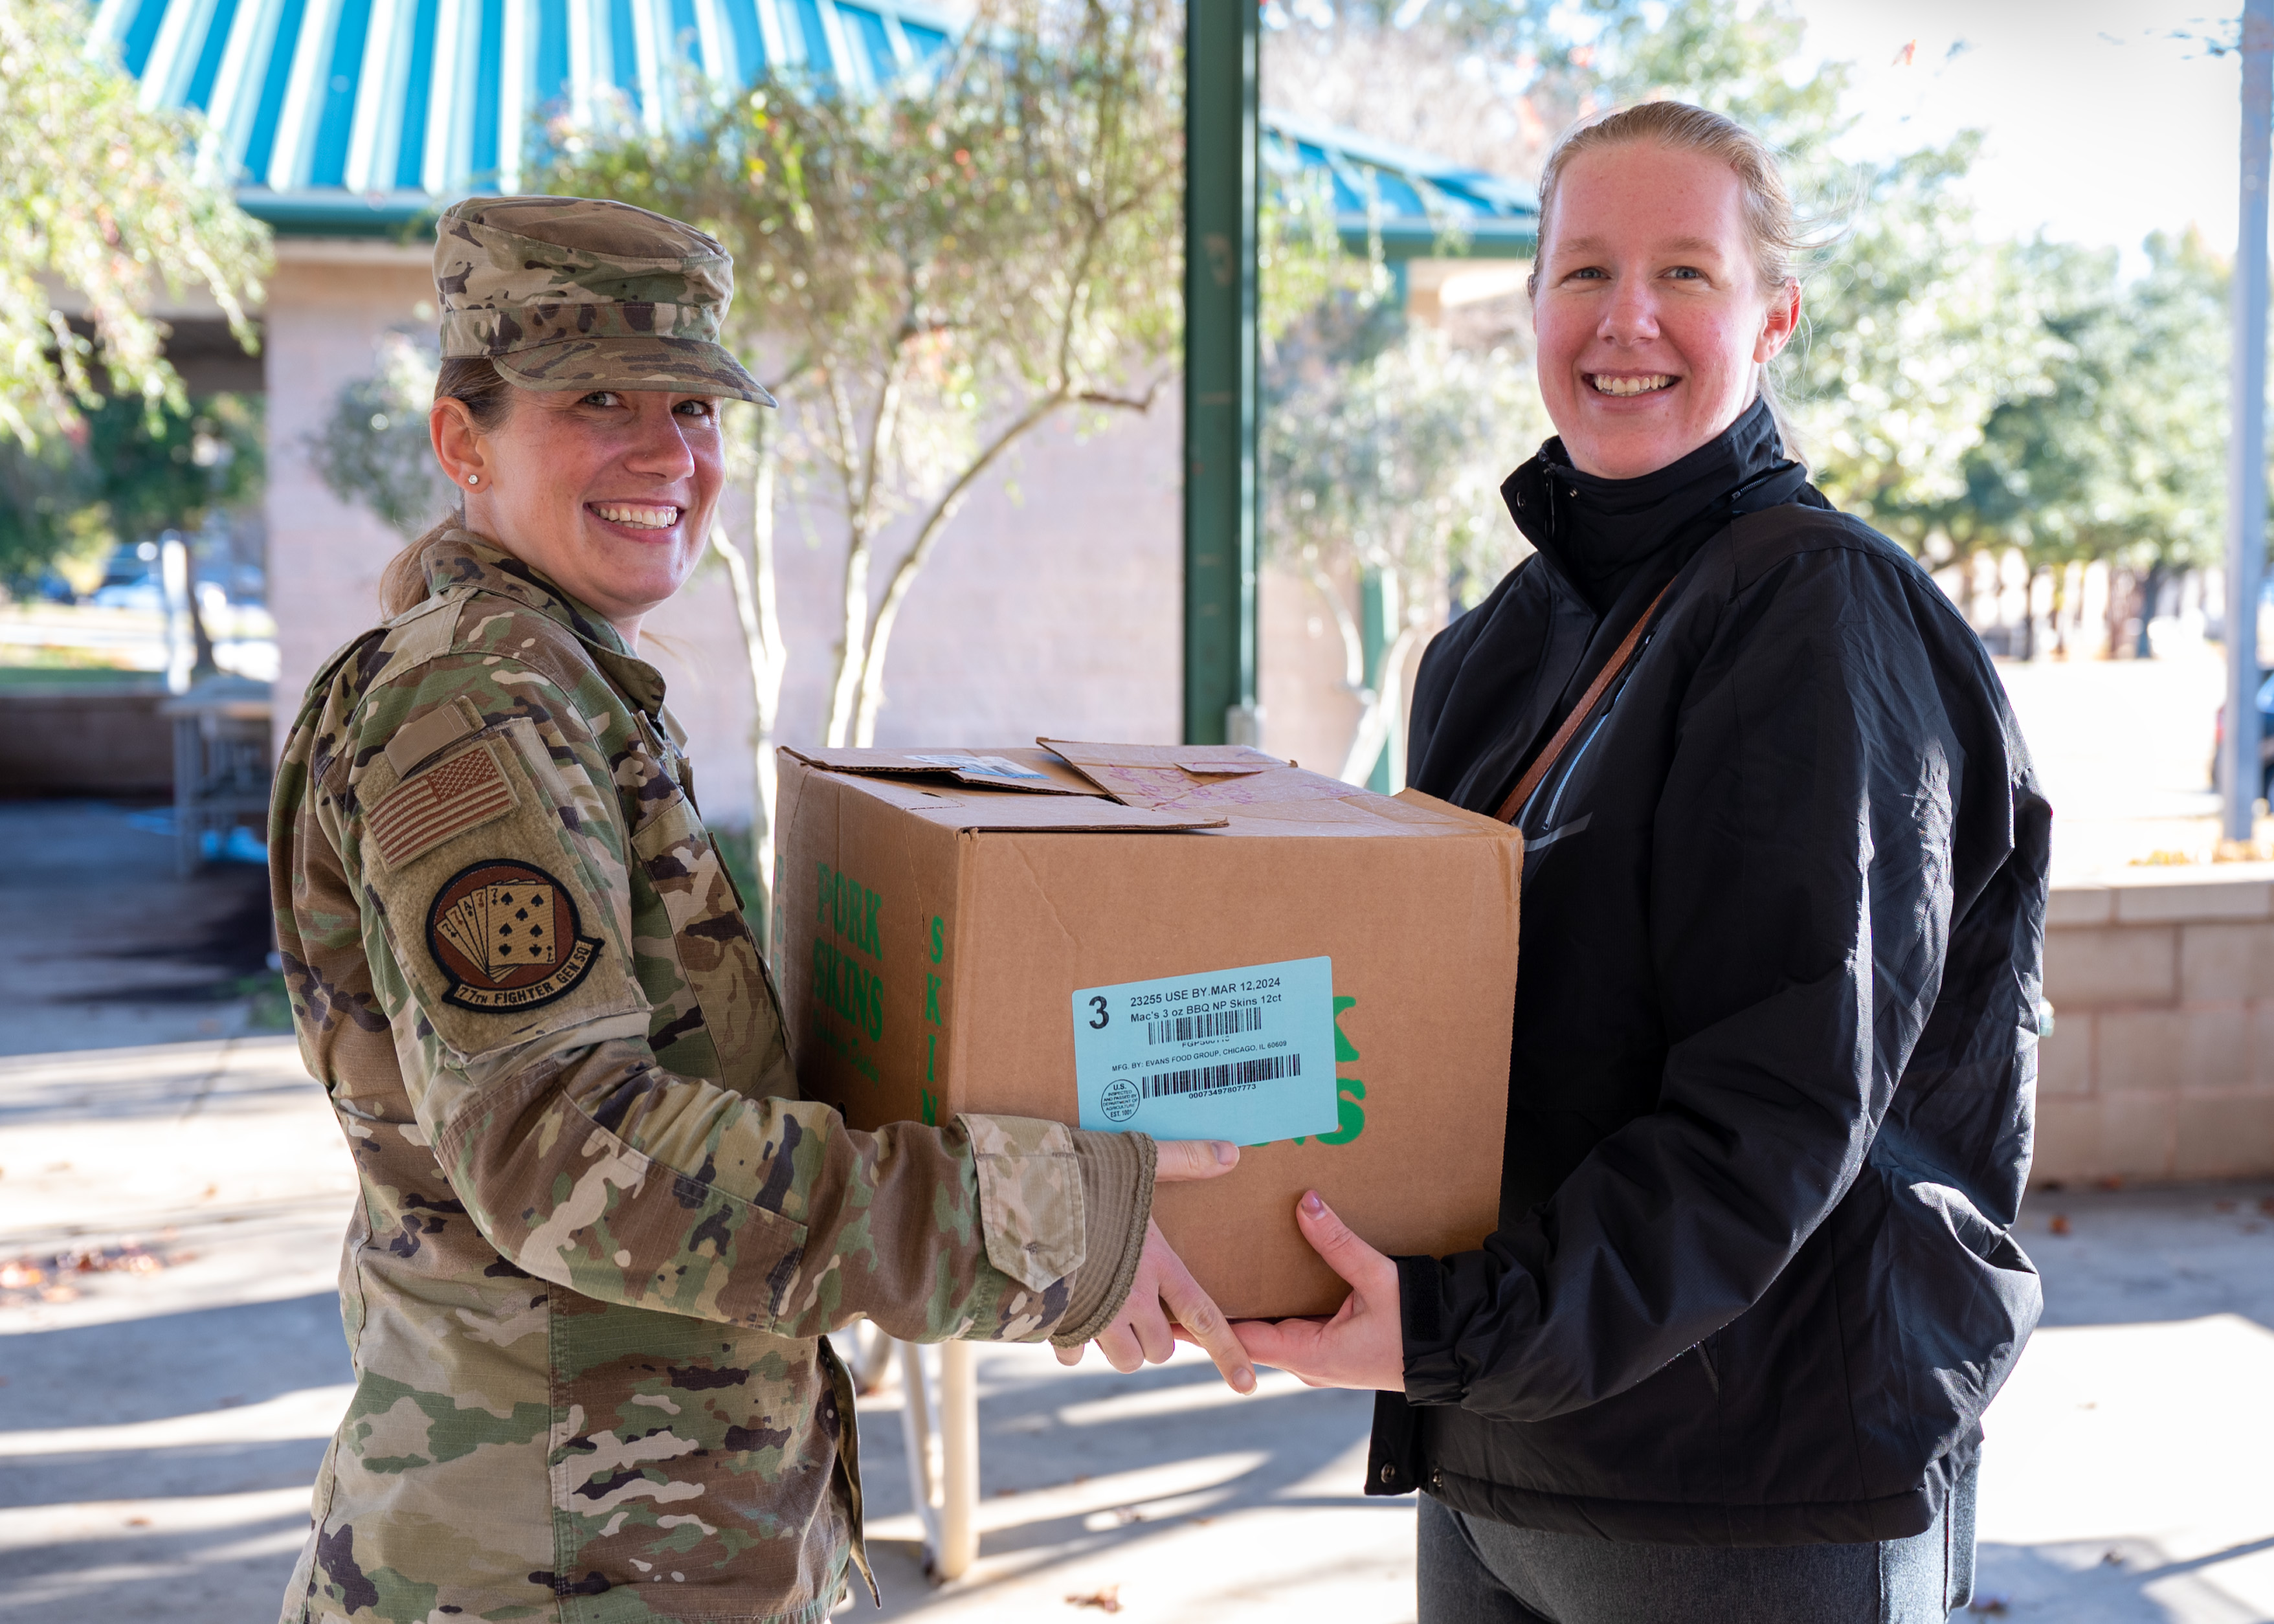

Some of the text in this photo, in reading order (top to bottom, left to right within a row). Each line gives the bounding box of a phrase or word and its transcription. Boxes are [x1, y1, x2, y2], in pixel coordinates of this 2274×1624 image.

[463, 900, 472, 911] A
[816, 862, 883, 962] PORK
[494, 981, 555, 1004] FIGHTER
[555, 962, 581, 984] GEN
[574, 946, 590, 962] SQ
[812, 937, 883, 1043] SKINS
[1130, 994, 1162, 1007] 23255
[1165, 990, 1188, 1002] USE
[1240, 977, 1280, 991] 12,2024
[1089, 996, 1109, 1029] 3
[1130, 1011, 1159, 1023] Mac's
[1163, 1009, 1168, 1018] 3
[1187, 1003, 1210, 1014] BBQ
[1213, 1001, 1227, 1010] NP
[1230, 998, 1257, 1008] Skins
[1261, 994, 1282, 1004] 12ct
[1146, 1057, 1170, 1067] EVANS
[1172, 1054, 1192, 1062] FOOD
[1194, 1050, 1221, 1060] GROUP,
[1223, 1045, 1257, 1055] CHICAGO,
[1267, 1040, 1287, 1049] 60609
[1188, 1084, 1256, 1099] 00073497807773
